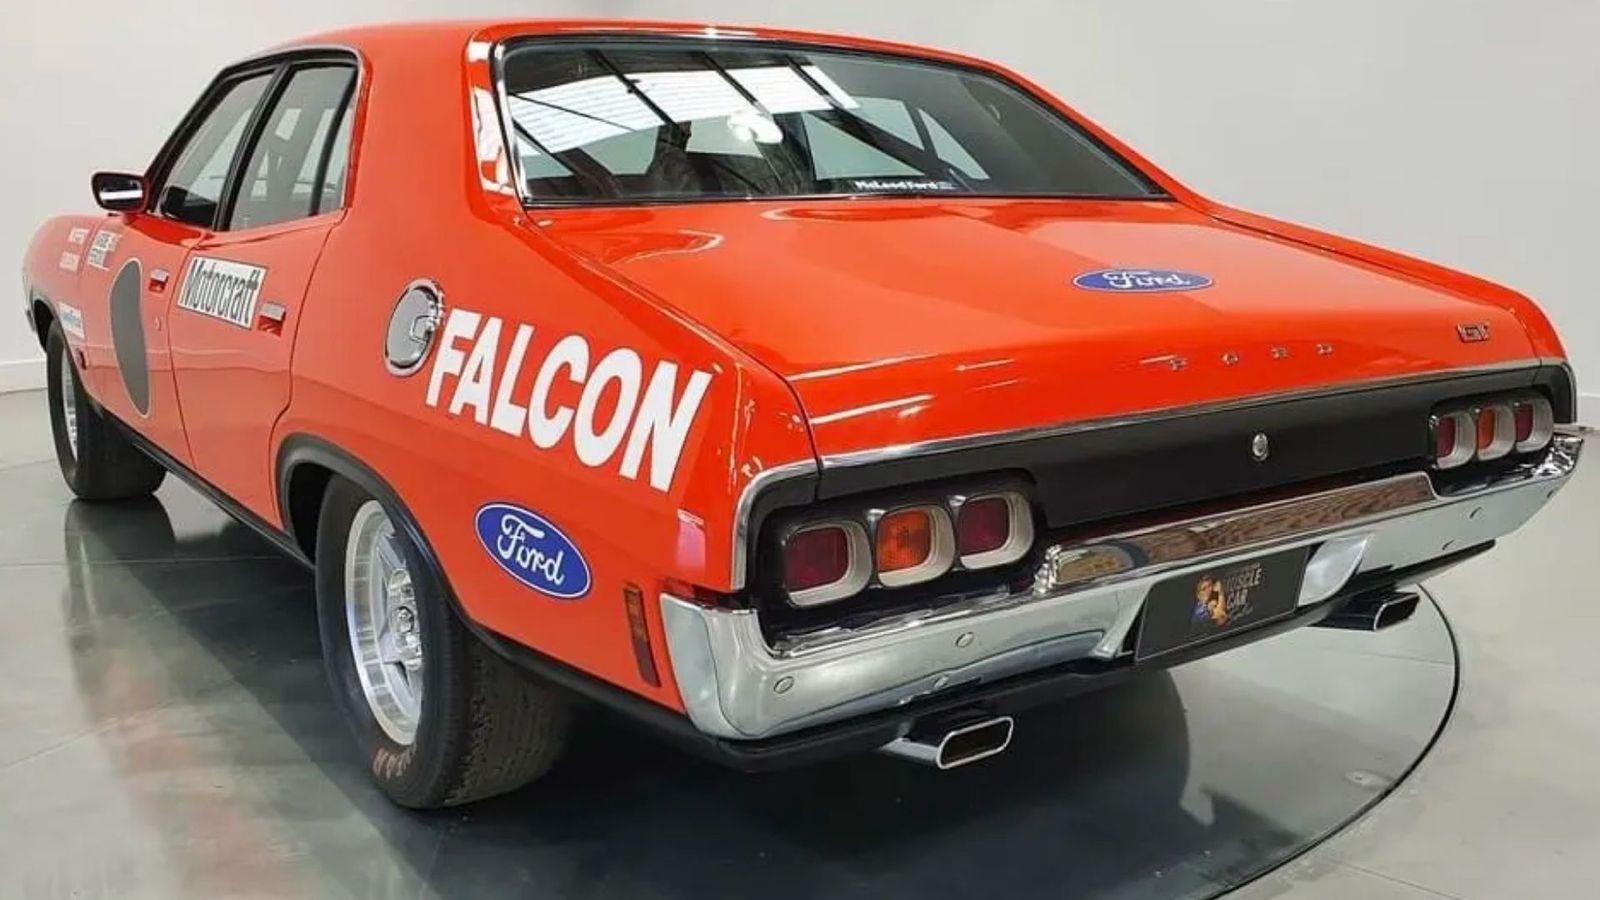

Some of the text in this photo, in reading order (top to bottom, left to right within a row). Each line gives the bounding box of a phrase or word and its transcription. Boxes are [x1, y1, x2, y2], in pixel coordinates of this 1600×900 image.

[182, 259, 260, 323] Motorcraft
[1102, 271, 1191, 289] Ford
[425, 308, 713, 493] FALCON
[497, 514, 564, 586] Ford
